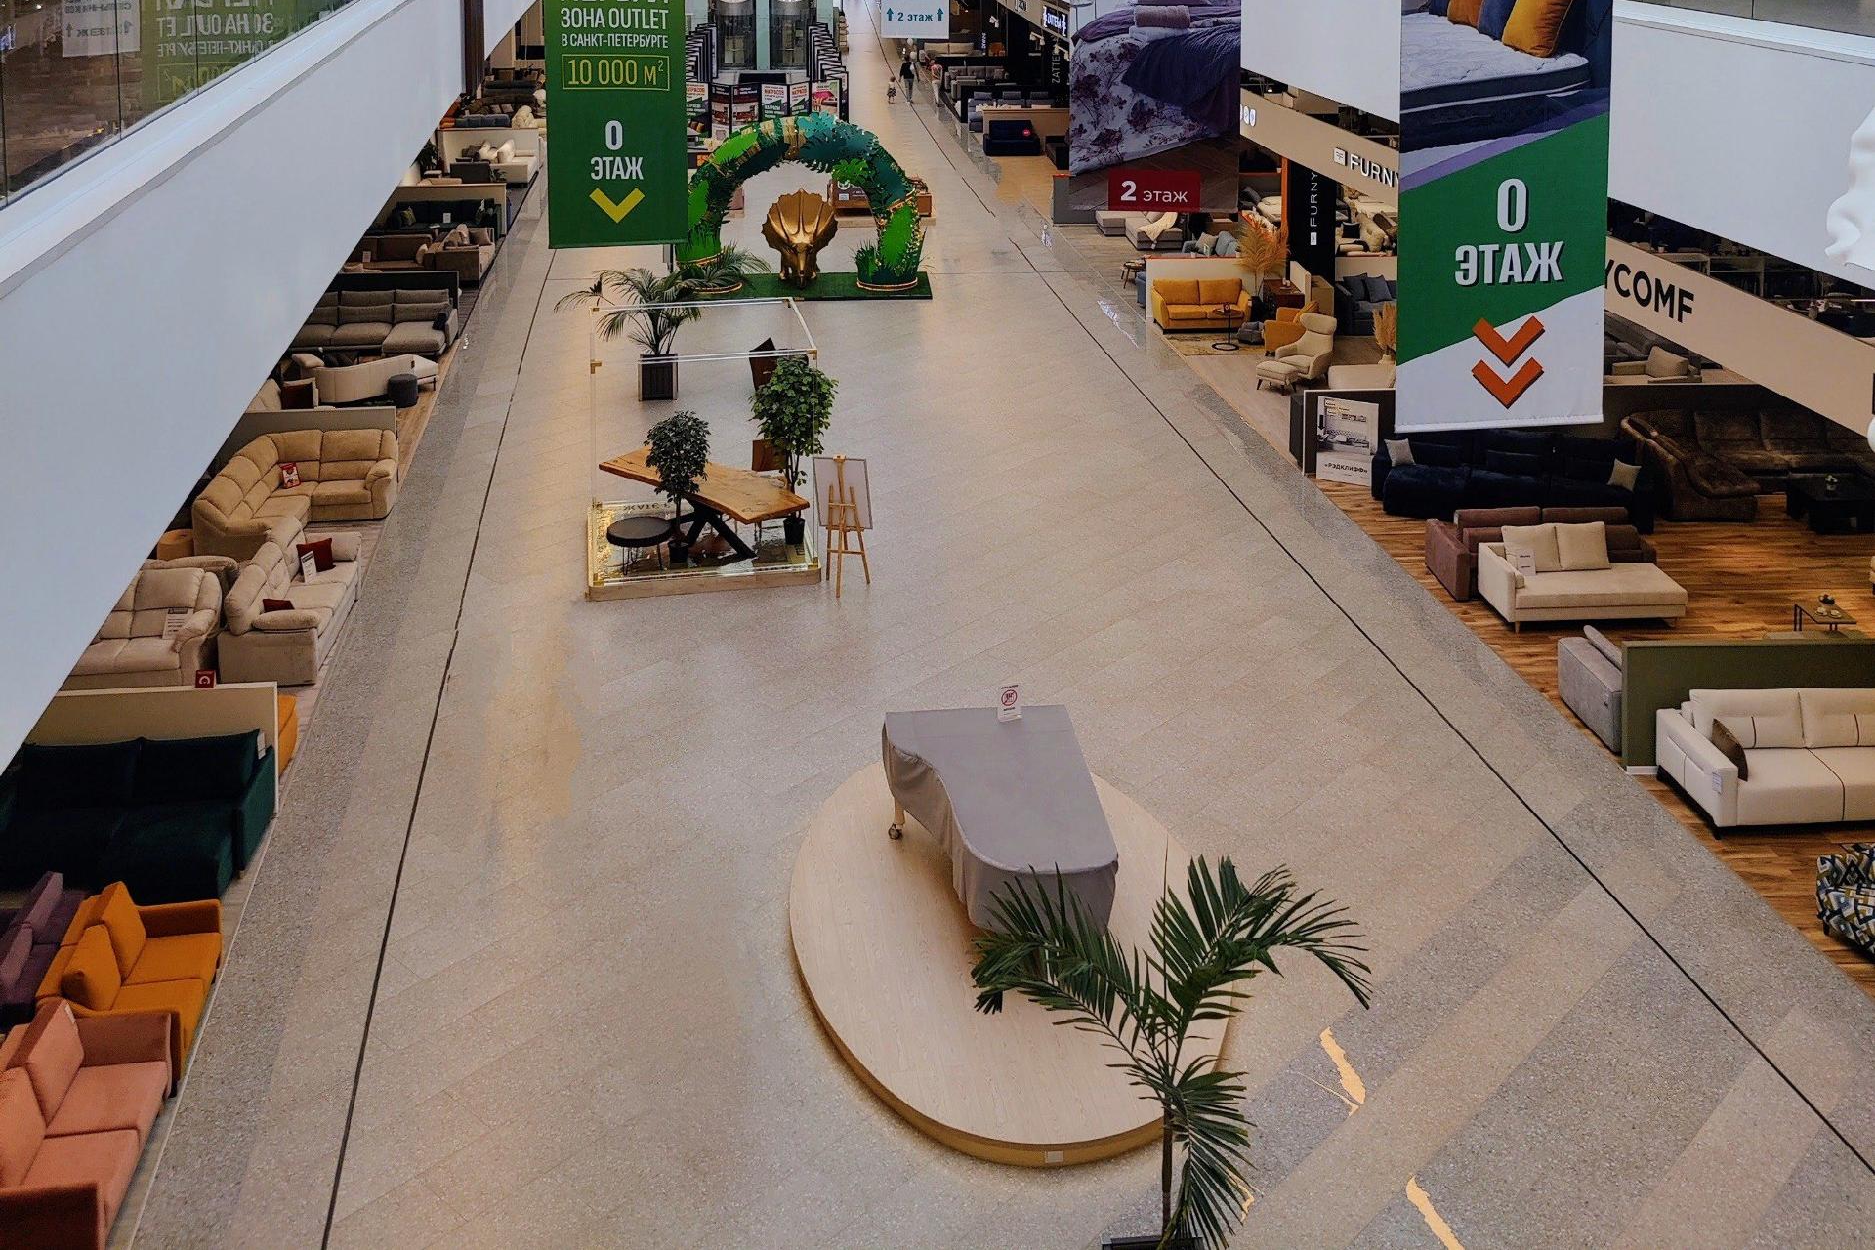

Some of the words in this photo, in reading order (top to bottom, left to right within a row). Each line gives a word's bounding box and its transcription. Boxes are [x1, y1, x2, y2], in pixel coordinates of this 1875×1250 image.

[561, 7, 605, 29] ЗОНА
[608, 8, 669, 30] OUTLET
[897, 12, 904, 22] 2
[907, 14, 933, 22] этаж
[561, 34, 568, 47] В
[569, 33, 669, 49] САНКТ-ПЕТЕРБУРГЕ
[568, 59, 592, 85] 10
[598, 60, 638, 85] 000
[604, 120, 623, 150] 0
[590, 156, 644, 181] ЭТАЖ
[1120, 180, 1137, 201] 2
[1143, 190, 1188, 203] этаж
[1496, 178, 1528, 233] 0
[1454, 240, 1565, 287] ЭТАЖ
